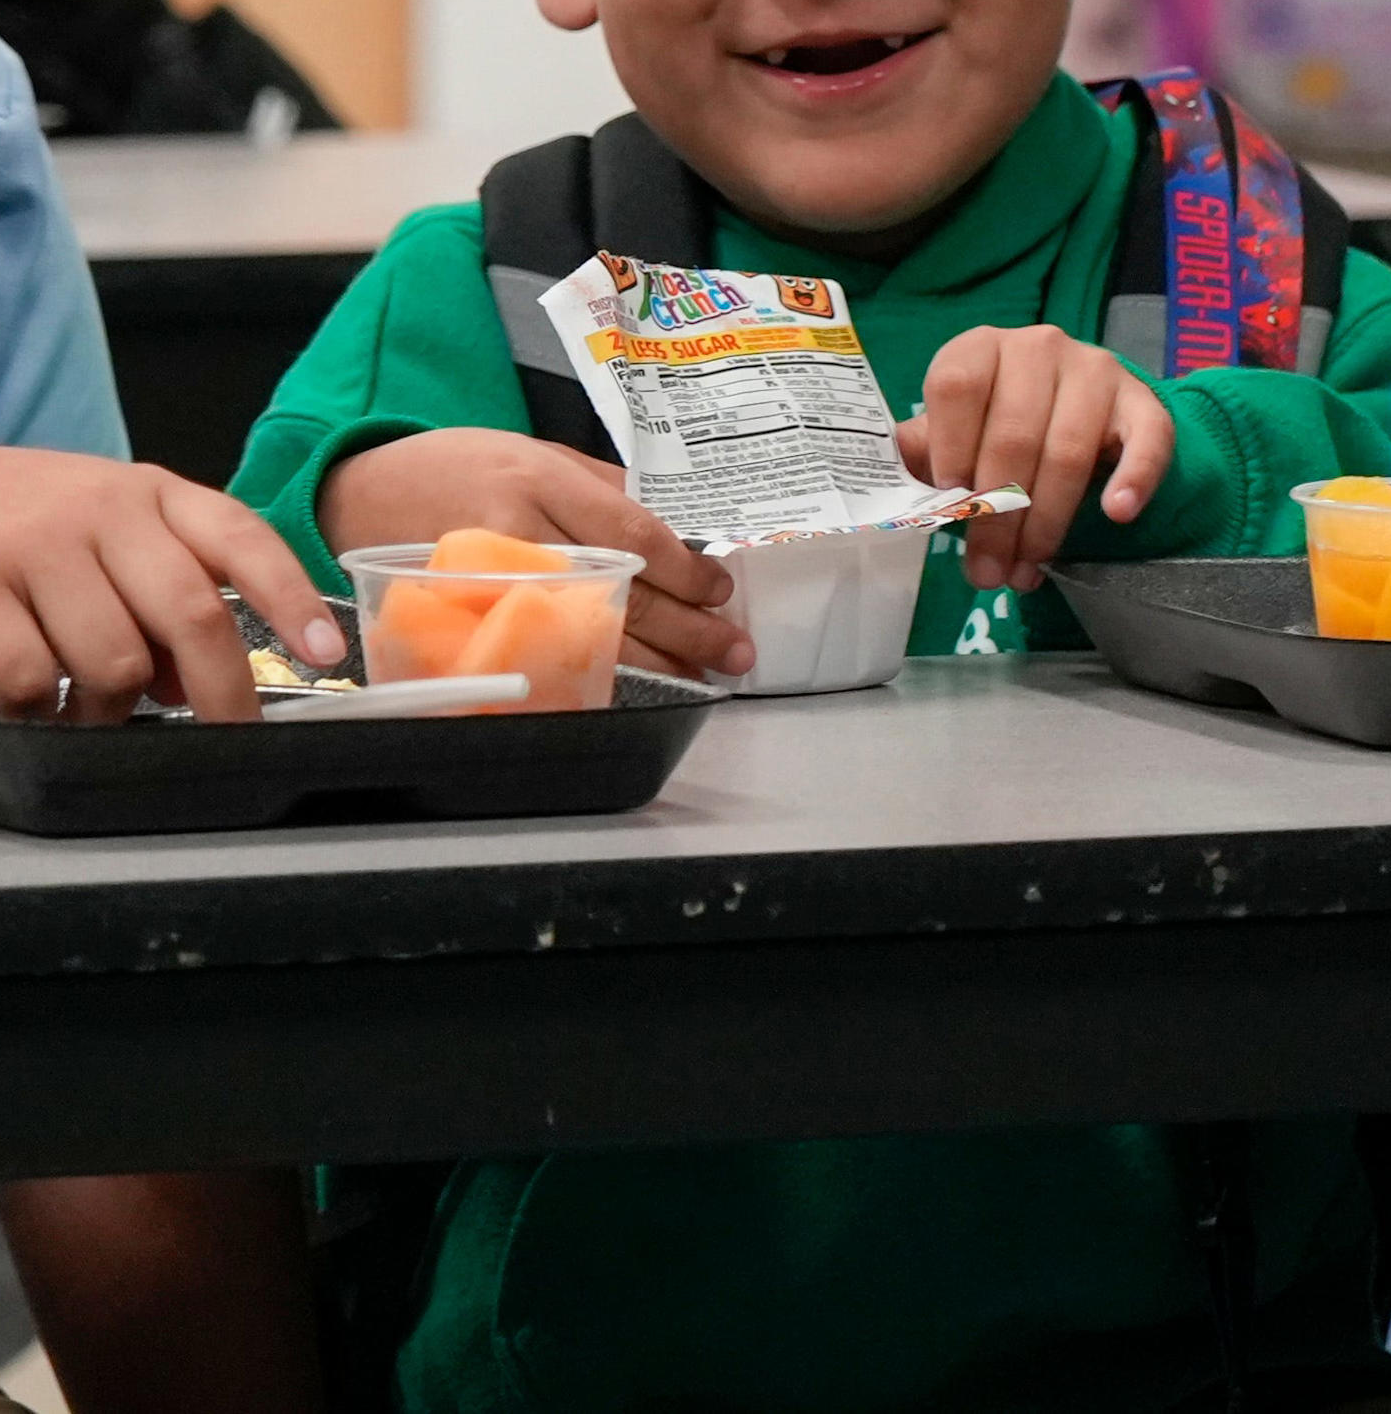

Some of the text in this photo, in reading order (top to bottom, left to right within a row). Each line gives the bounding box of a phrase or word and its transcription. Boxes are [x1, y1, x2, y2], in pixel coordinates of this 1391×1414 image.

[1175, 190, 1232, 378] SPIDER-M
[630, 339, 668, 359] LESS
[672, 334, 741, 359] SUGAR
